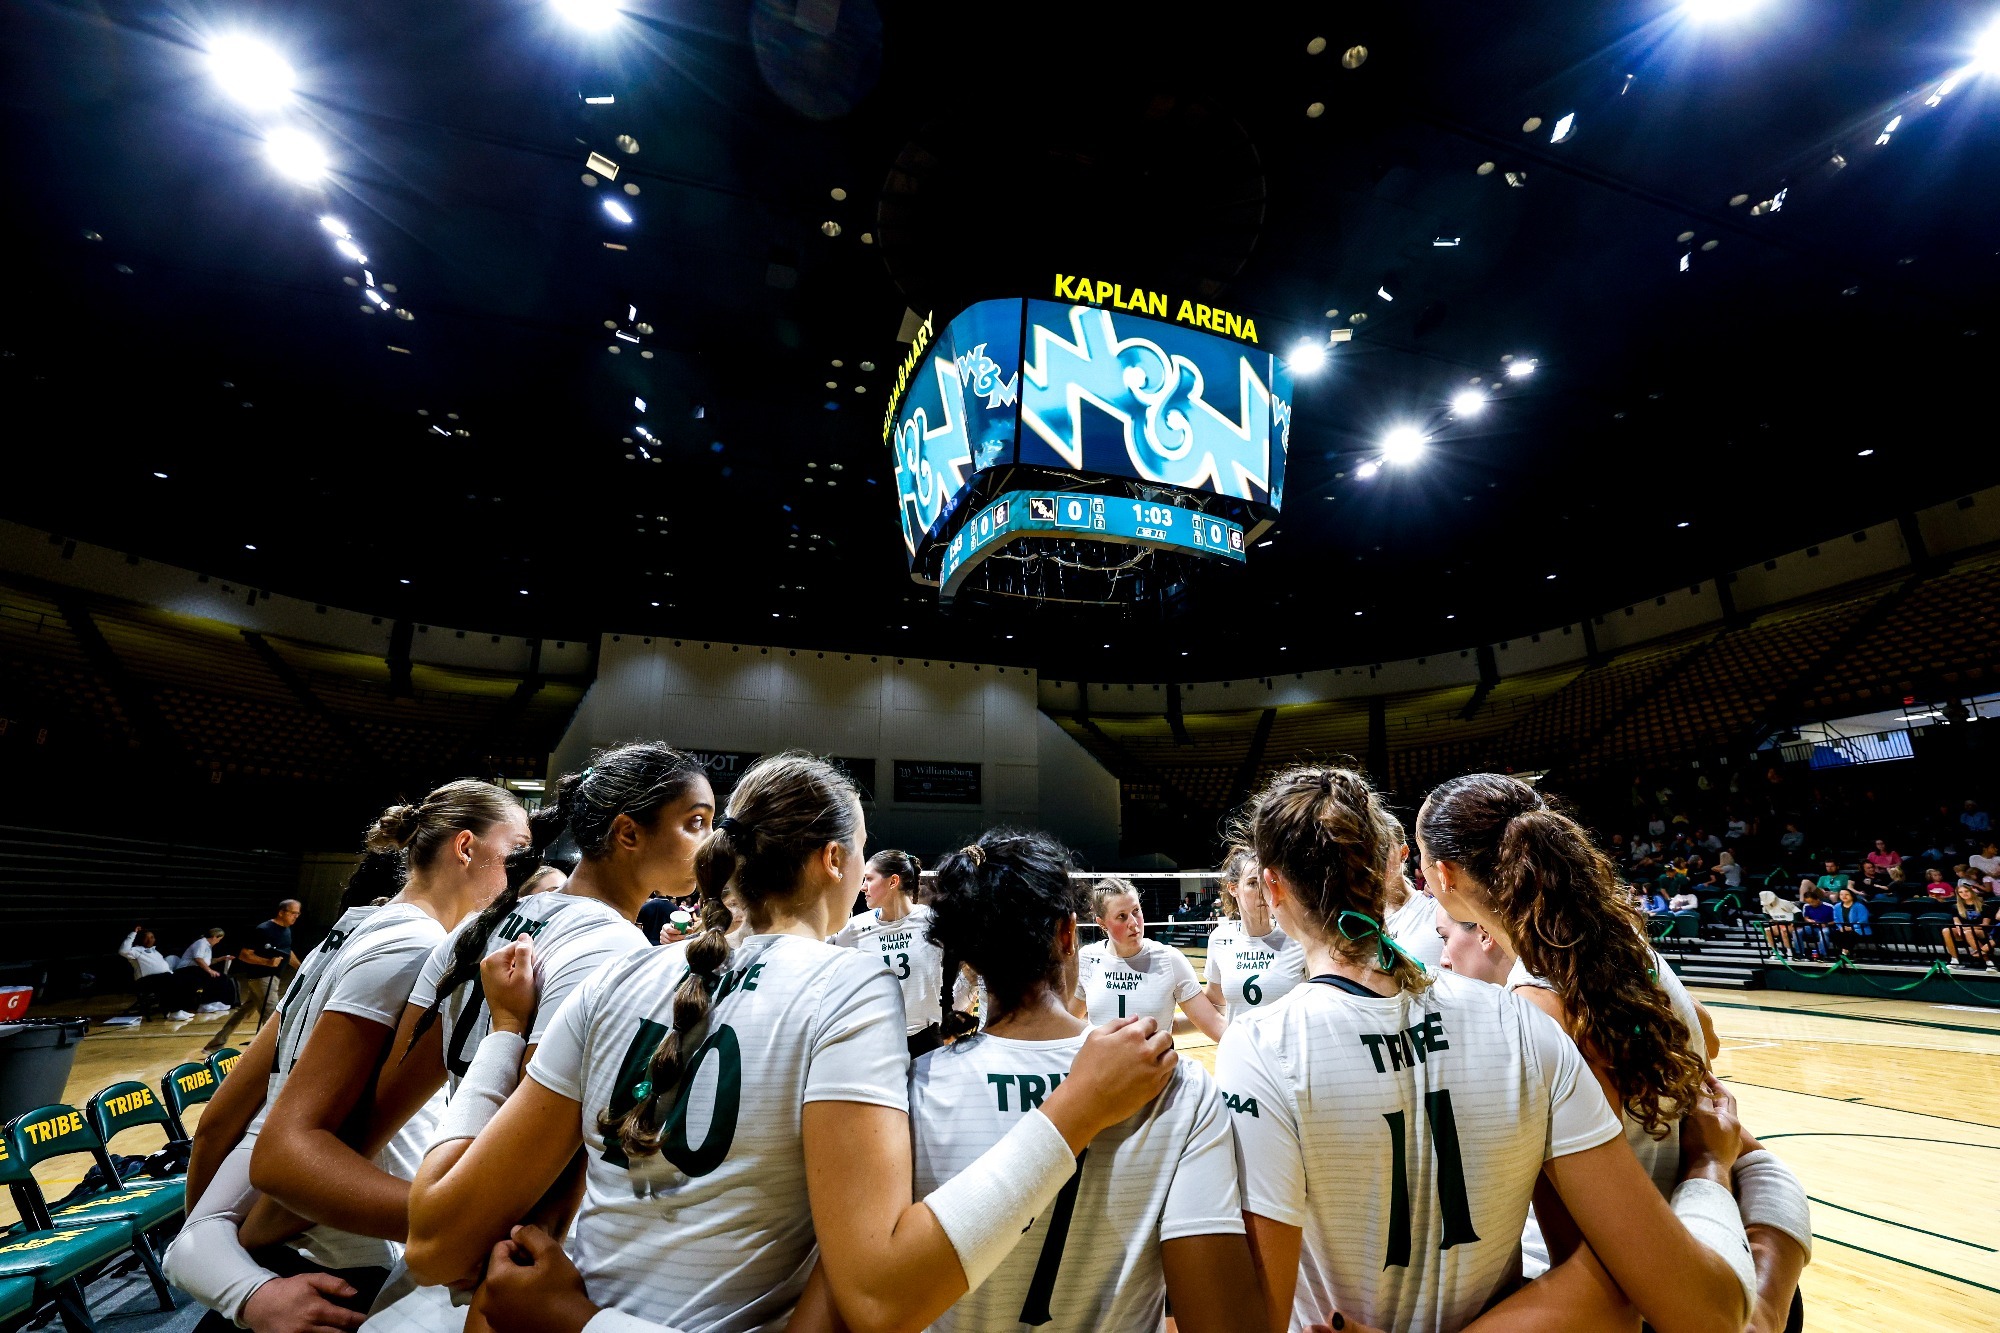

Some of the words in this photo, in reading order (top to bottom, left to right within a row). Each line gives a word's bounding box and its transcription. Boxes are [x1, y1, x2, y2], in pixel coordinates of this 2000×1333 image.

[1055, 274, 1167, 317] KAPLAN
[1176, 300, 1258, 343] ARENA
[1067, 500, 1082, 521] 0
[1132, 503, 1172, 527] 1:03
[1210, 524, 1221, 543] 0
[916, 766, 973, 777] Williamsburg
[879, 932, 912, 943] WILLIAM
[881, 940, 910, 951] &MARY
[1236, 951, 1275, 962] WILLIAM
[1236, 961, 1271, 971] &MARY
[1104, 971, 1143, 982] WILLIAM
[1106, 981, 1139, 991] &MARY
[1242, 974, 1263, 1006] 6
[7, 995, 20, 1009] G
[1117, 994, 1126, 1019] 1
[177, 1068, 214, 1093] TRIBE
[105, 1088, 154, 1118] TRIBE
[24, 1111, 83, 1145] TRIBE
[1382, 1089, 1482, 1272] 11
